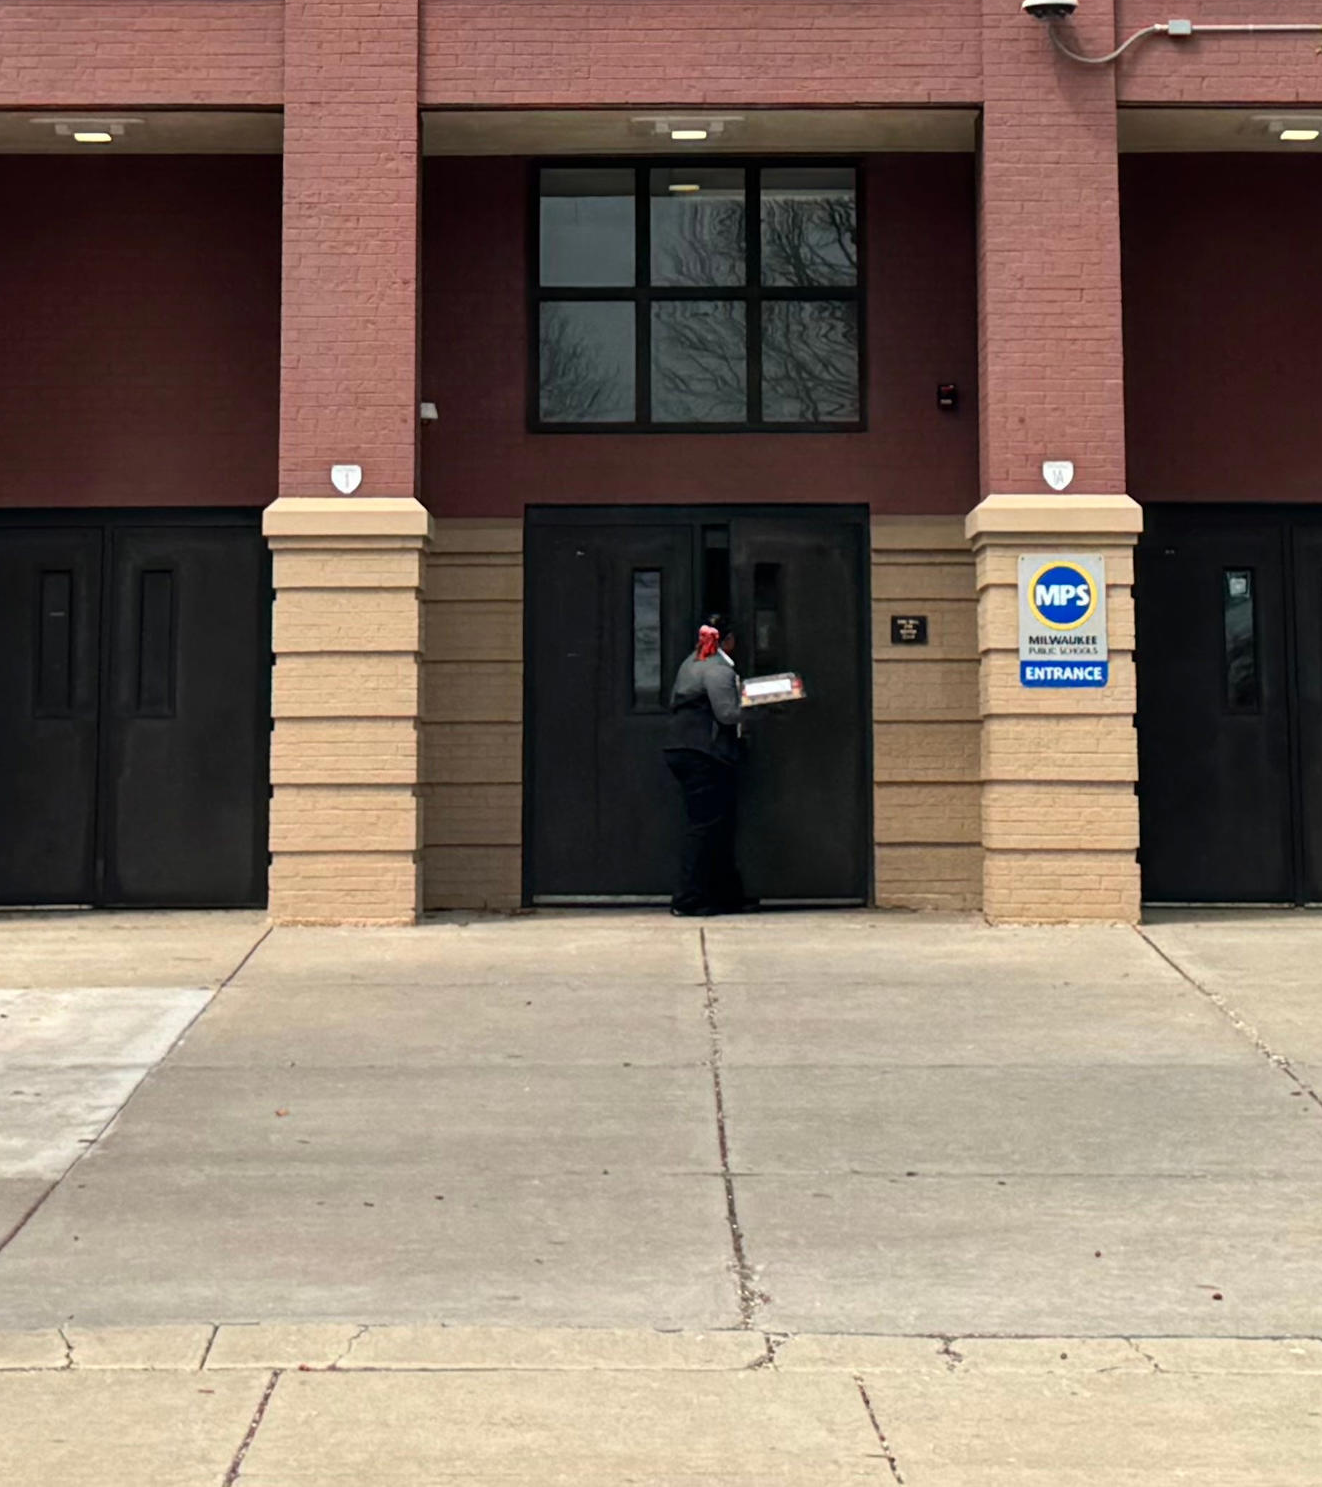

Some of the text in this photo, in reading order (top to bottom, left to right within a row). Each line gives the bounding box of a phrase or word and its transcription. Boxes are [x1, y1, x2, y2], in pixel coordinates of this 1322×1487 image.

[1035, 584, 1090, 606] MPS
[1028, 635, 1098, 645] MILWAUKEE
[1028, 647, 1098, 655] PUBLIC SCHOOLS
[1025, 667, 1103, 681] ENTRANCE
